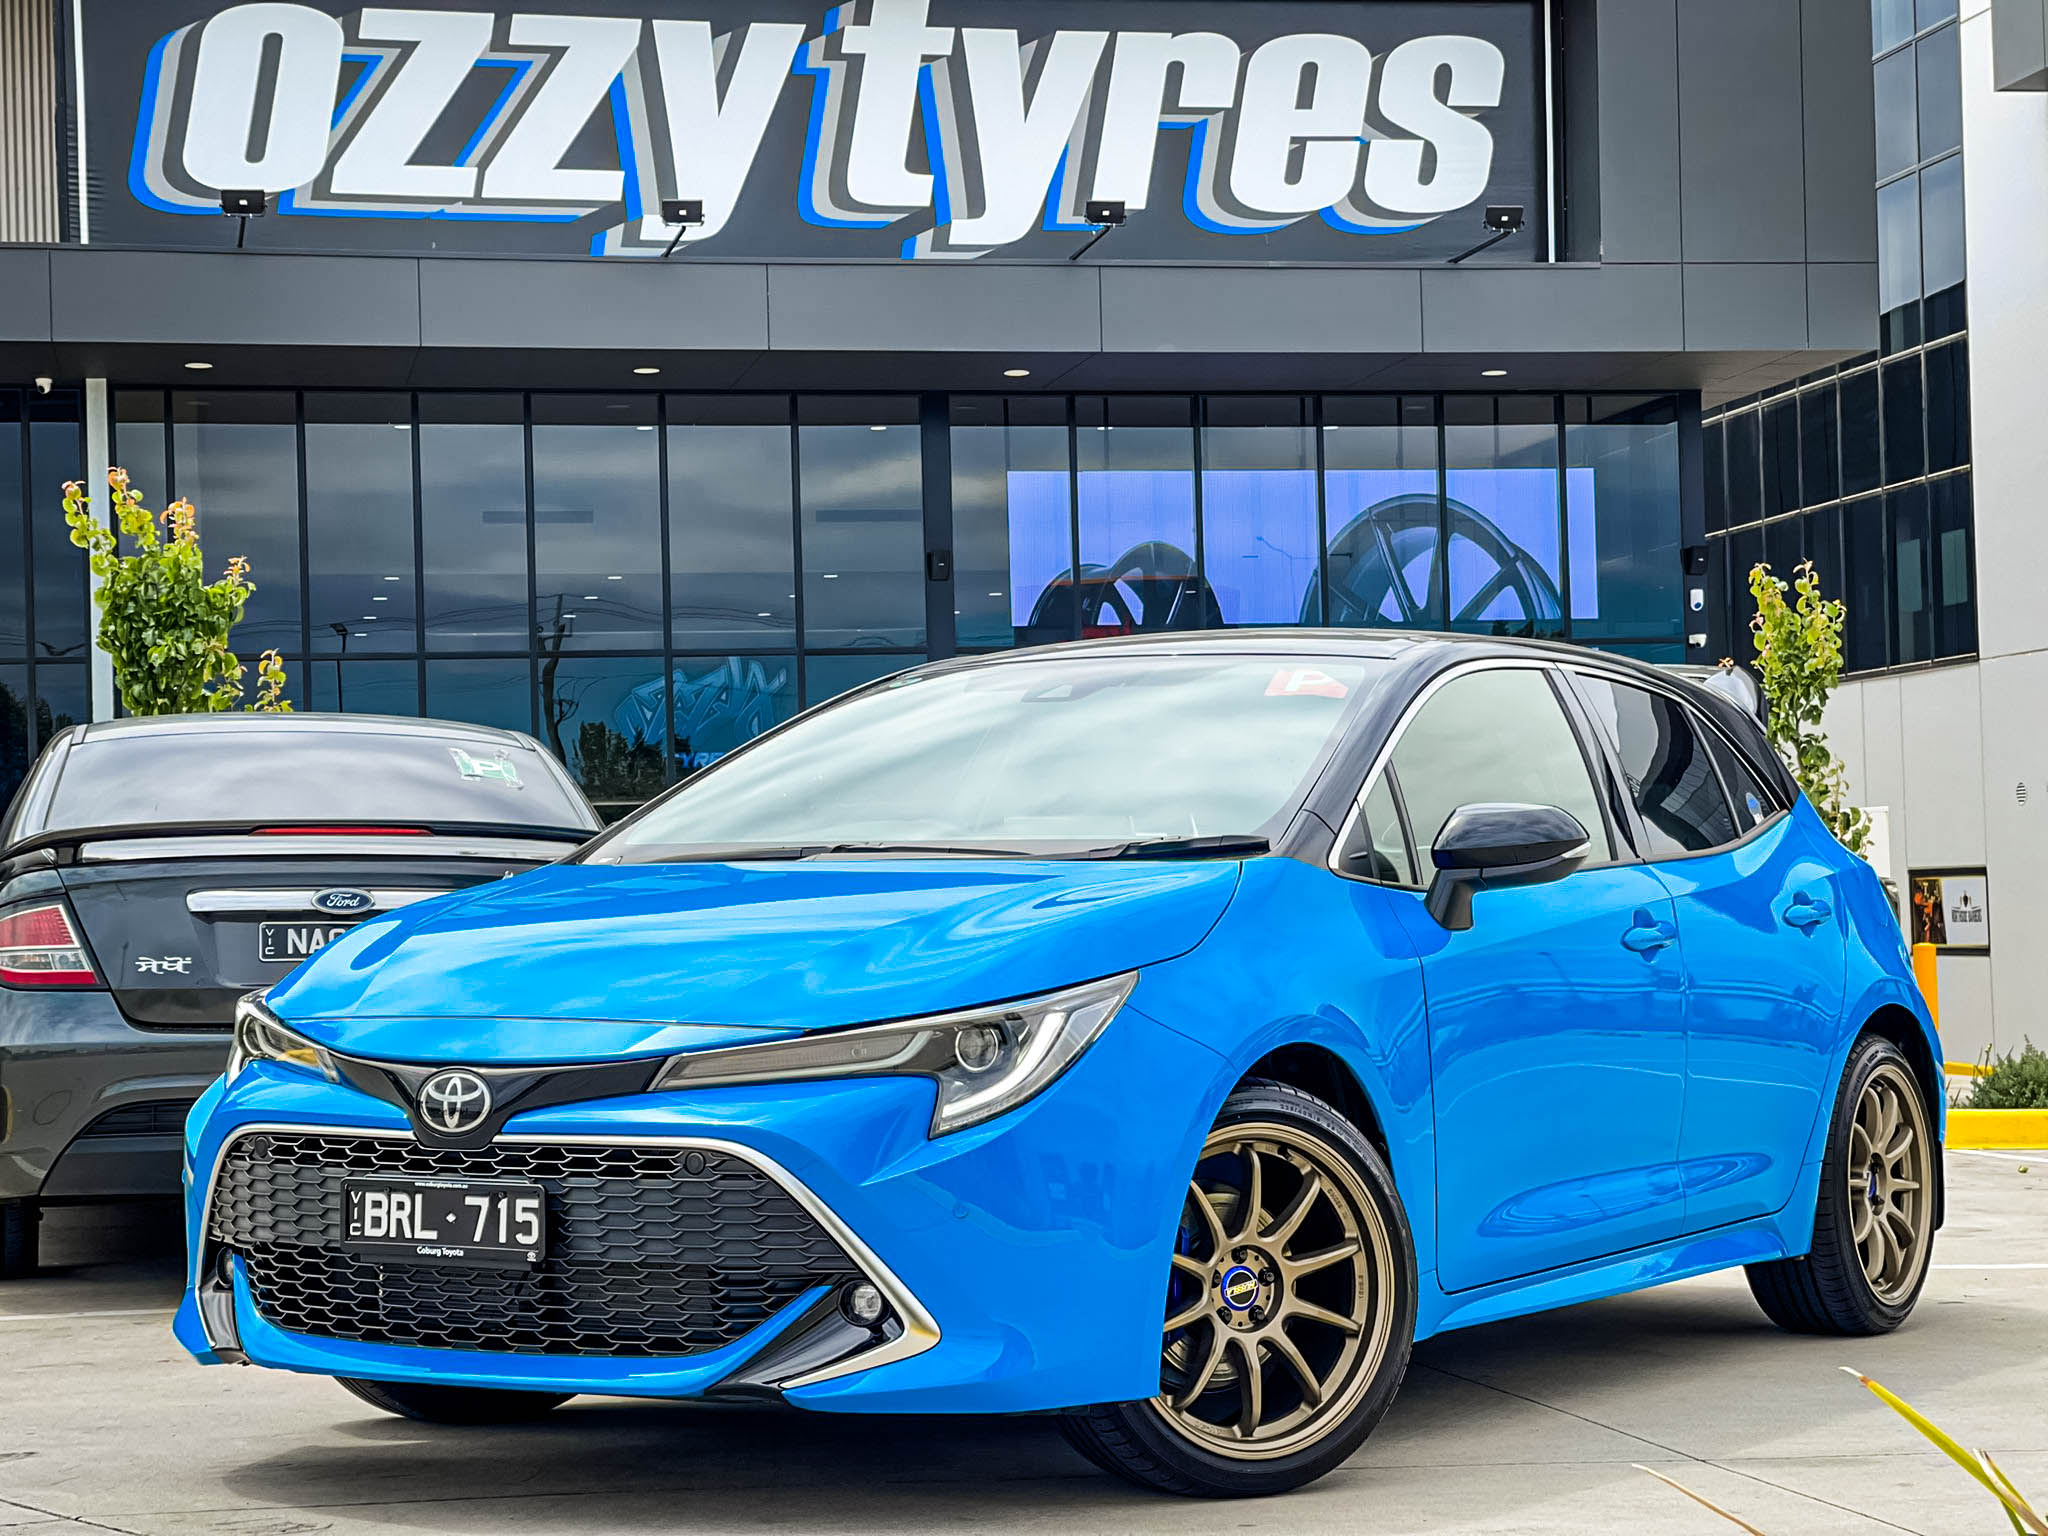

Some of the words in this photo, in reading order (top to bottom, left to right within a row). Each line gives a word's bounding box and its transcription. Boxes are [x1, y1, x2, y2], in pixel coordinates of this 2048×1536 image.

[326, 893, 360, 907] Ford
[264, 928, 275, 955] VIC
[349, 1191, 362, 1236] VIC
[363, 1191, 438, 1241] BRL
[464, 1195, 540, 1245] 715
[416, 1246, 441, 1257] Coburg
[441, 1247, 464, 1258] Toyota
